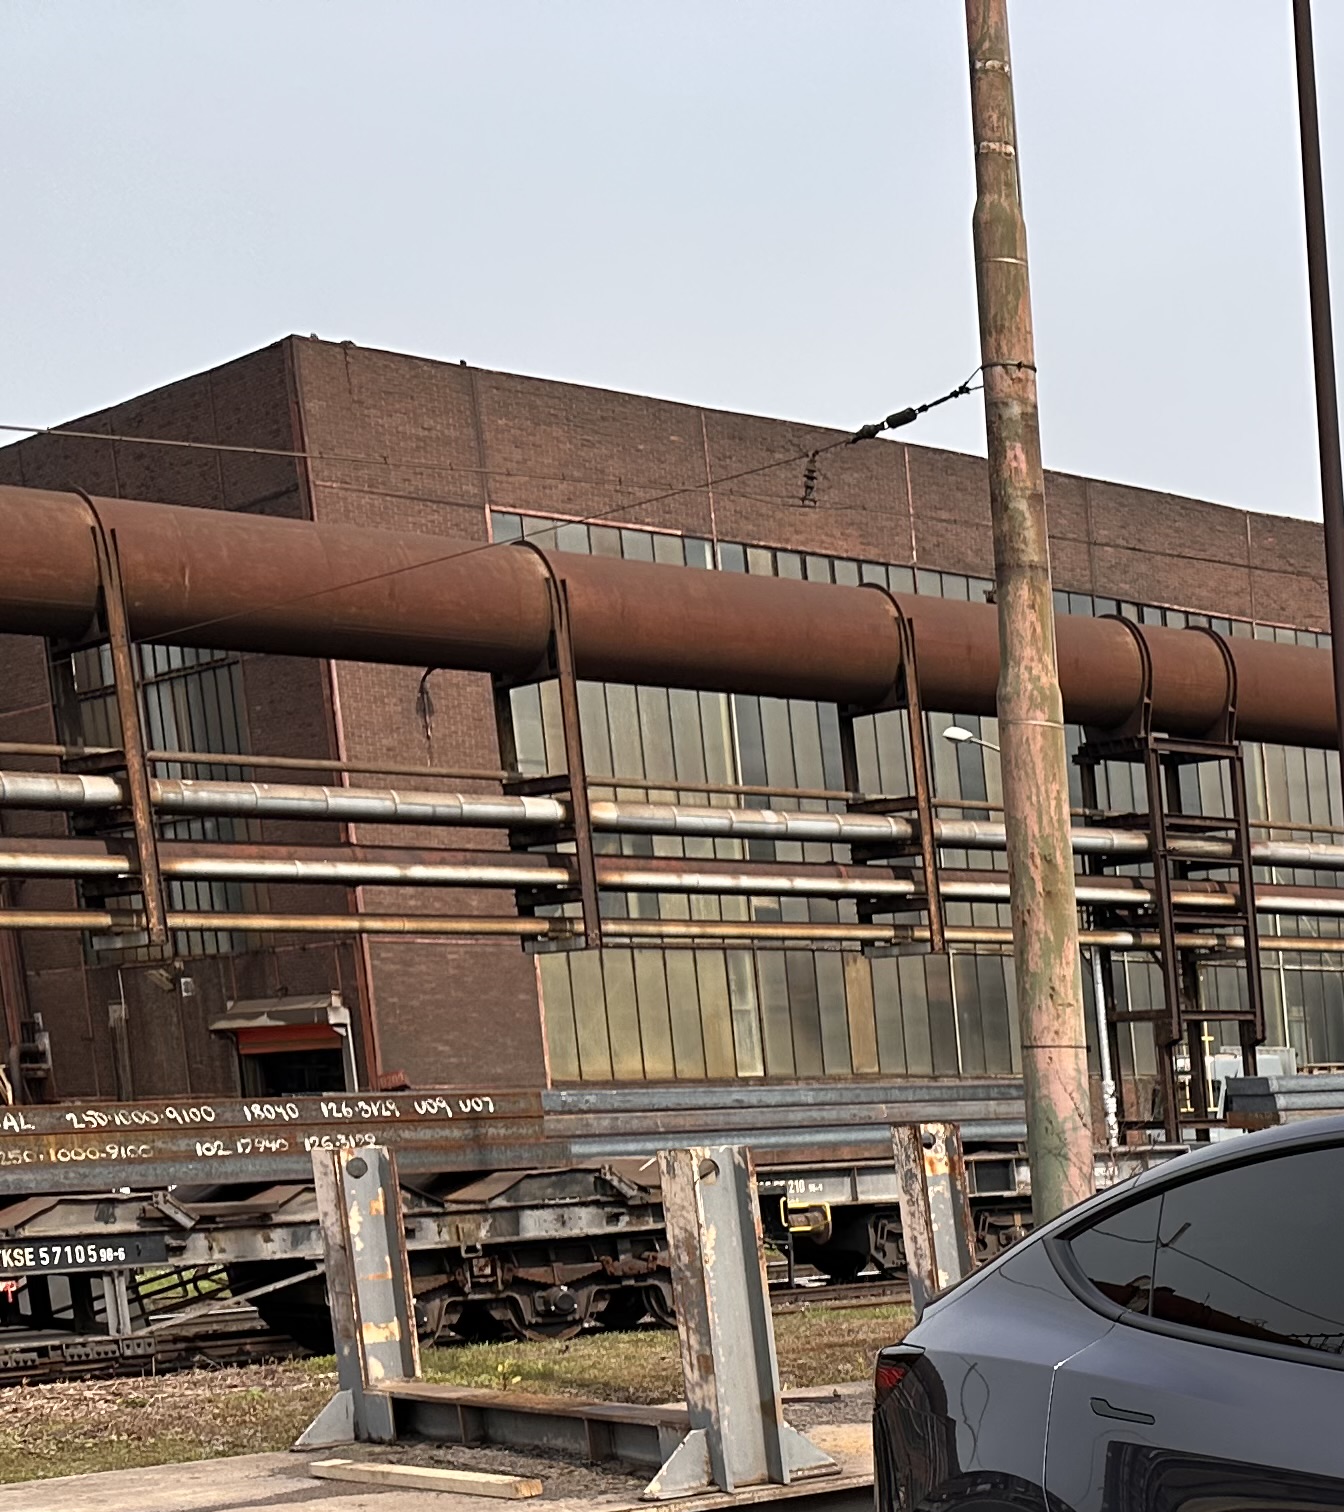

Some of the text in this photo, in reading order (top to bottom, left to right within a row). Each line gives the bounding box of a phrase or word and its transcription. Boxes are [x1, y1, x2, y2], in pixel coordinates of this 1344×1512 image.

[243, 1103, 299, 1121] 18040
[0, 1247, 36, 1267] KSE
[39, 1244, 97, 1265] 57105
